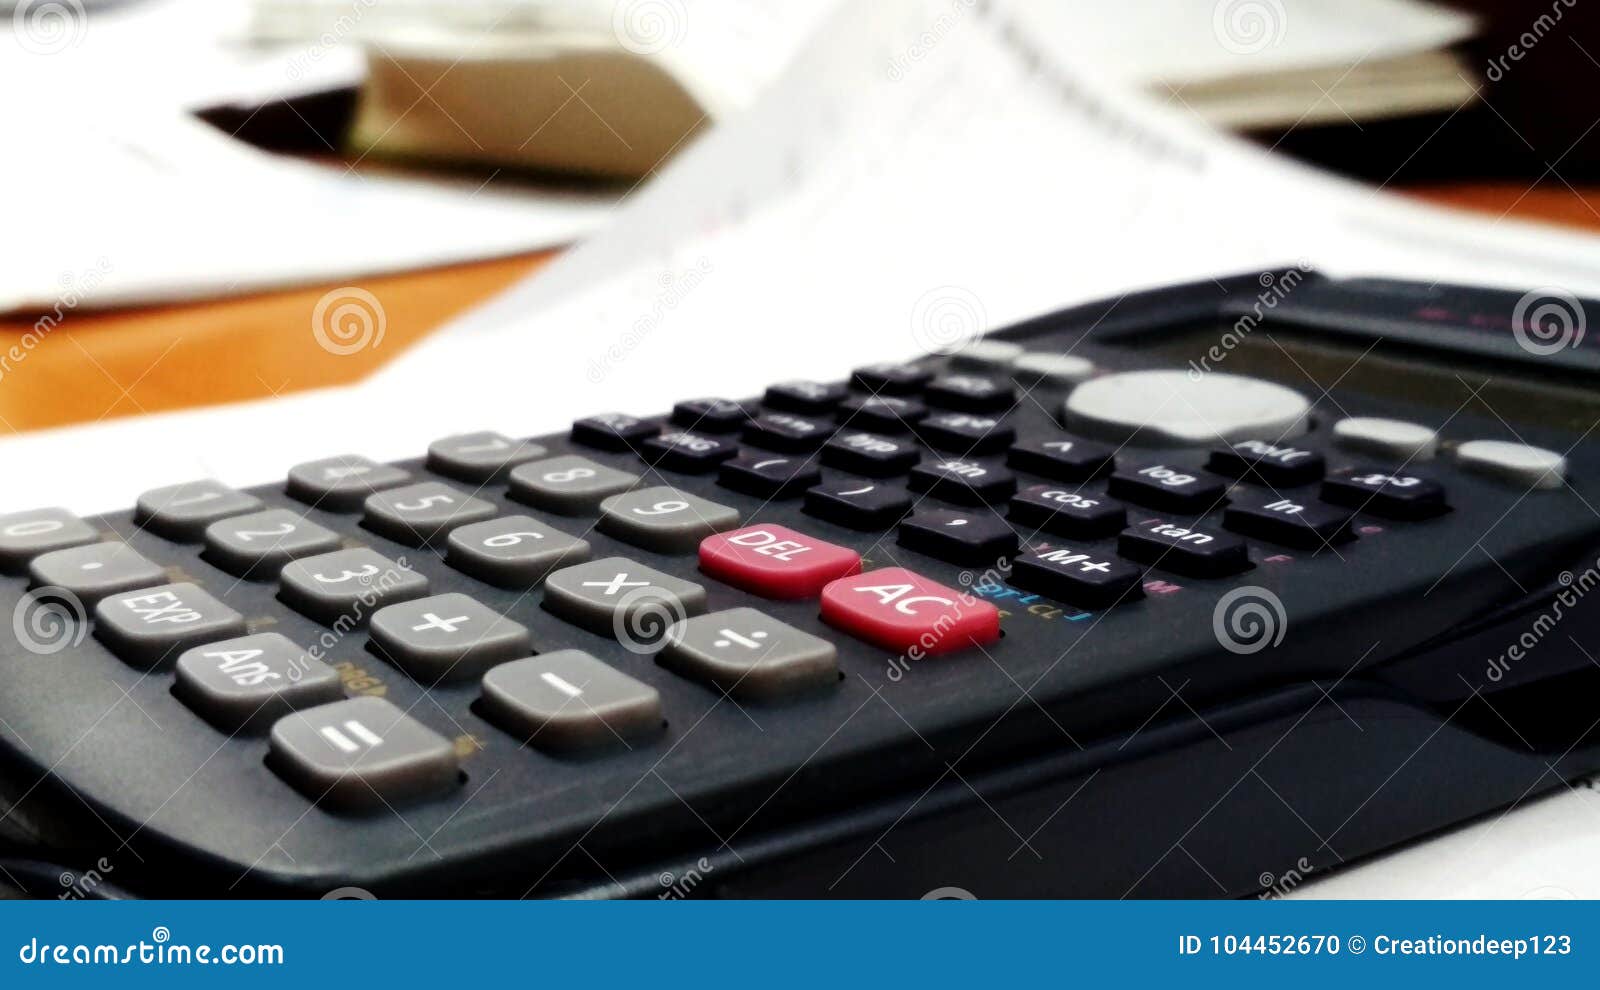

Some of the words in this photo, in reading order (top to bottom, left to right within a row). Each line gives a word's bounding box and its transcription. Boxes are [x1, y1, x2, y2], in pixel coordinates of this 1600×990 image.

[543, 467, 596, 483] 8
[936, 461, 987, 478] sin
[1138, 465, 1197, 486] log
[395, 494, 454, 511] 5
[632, 499, 690, 516] 9
[1041, 491, 1098, 509] cos
[1263, 500, 1304, 514] ln
[5, 520, 64, 537] 0
[234, 522, 296, 542] 2
[1150, 523, 1215, 545] tan
[483, 532, 544, 548] 6
[727, 530, 813, 562] DEL
[1037, 549, 1111, 573] M+
[313, 564, 380, 585] 3
[122, 591, 202, 624] EXP
[854, 581, 953, 615] AC
[203, 648, 281, 687] Ans
